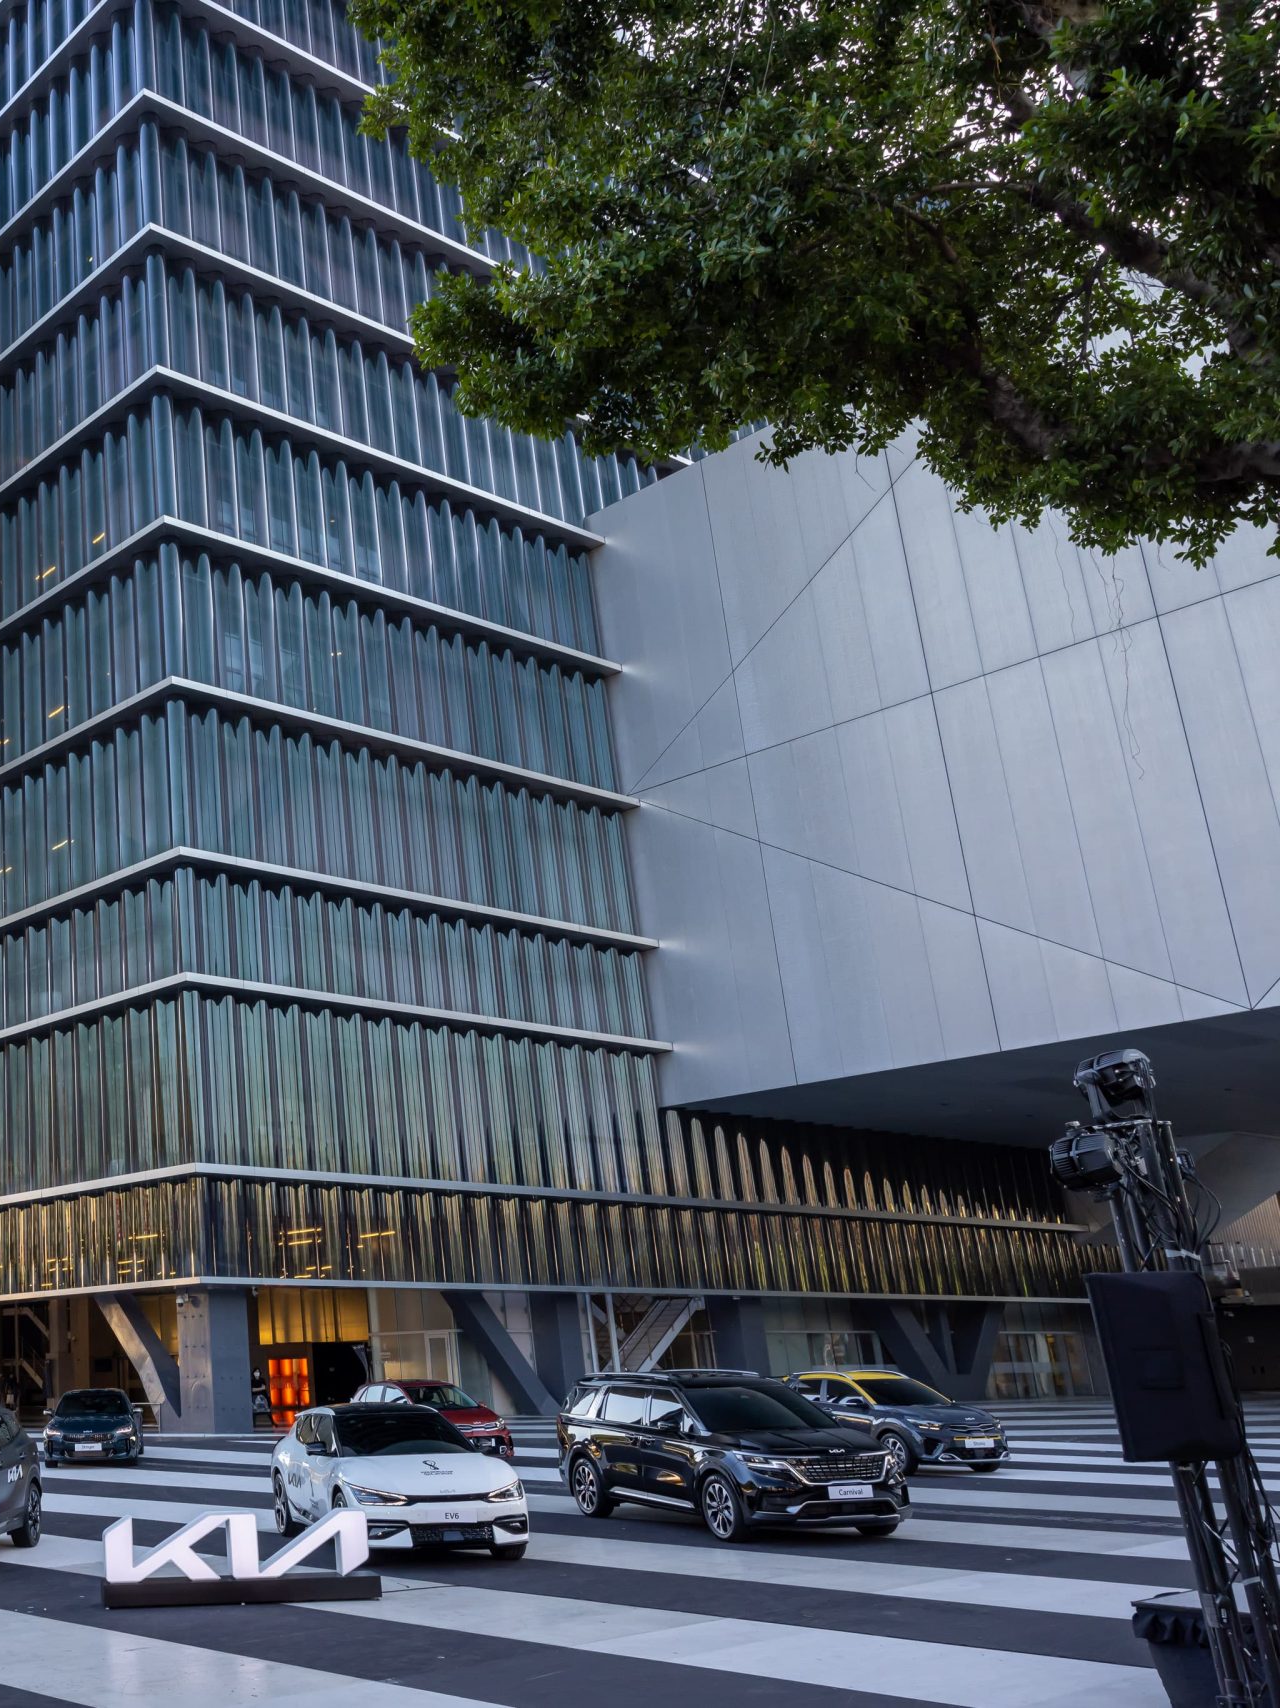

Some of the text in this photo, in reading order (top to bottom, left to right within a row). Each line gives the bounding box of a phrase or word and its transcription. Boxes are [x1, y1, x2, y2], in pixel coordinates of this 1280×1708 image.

[7, 1464, 24, 1483] KIA
[838, 1488, 864, 1496] Carnival
[444, 1512, 460, 1520] EV6
[102, 1508, 370, 1583] KIA
